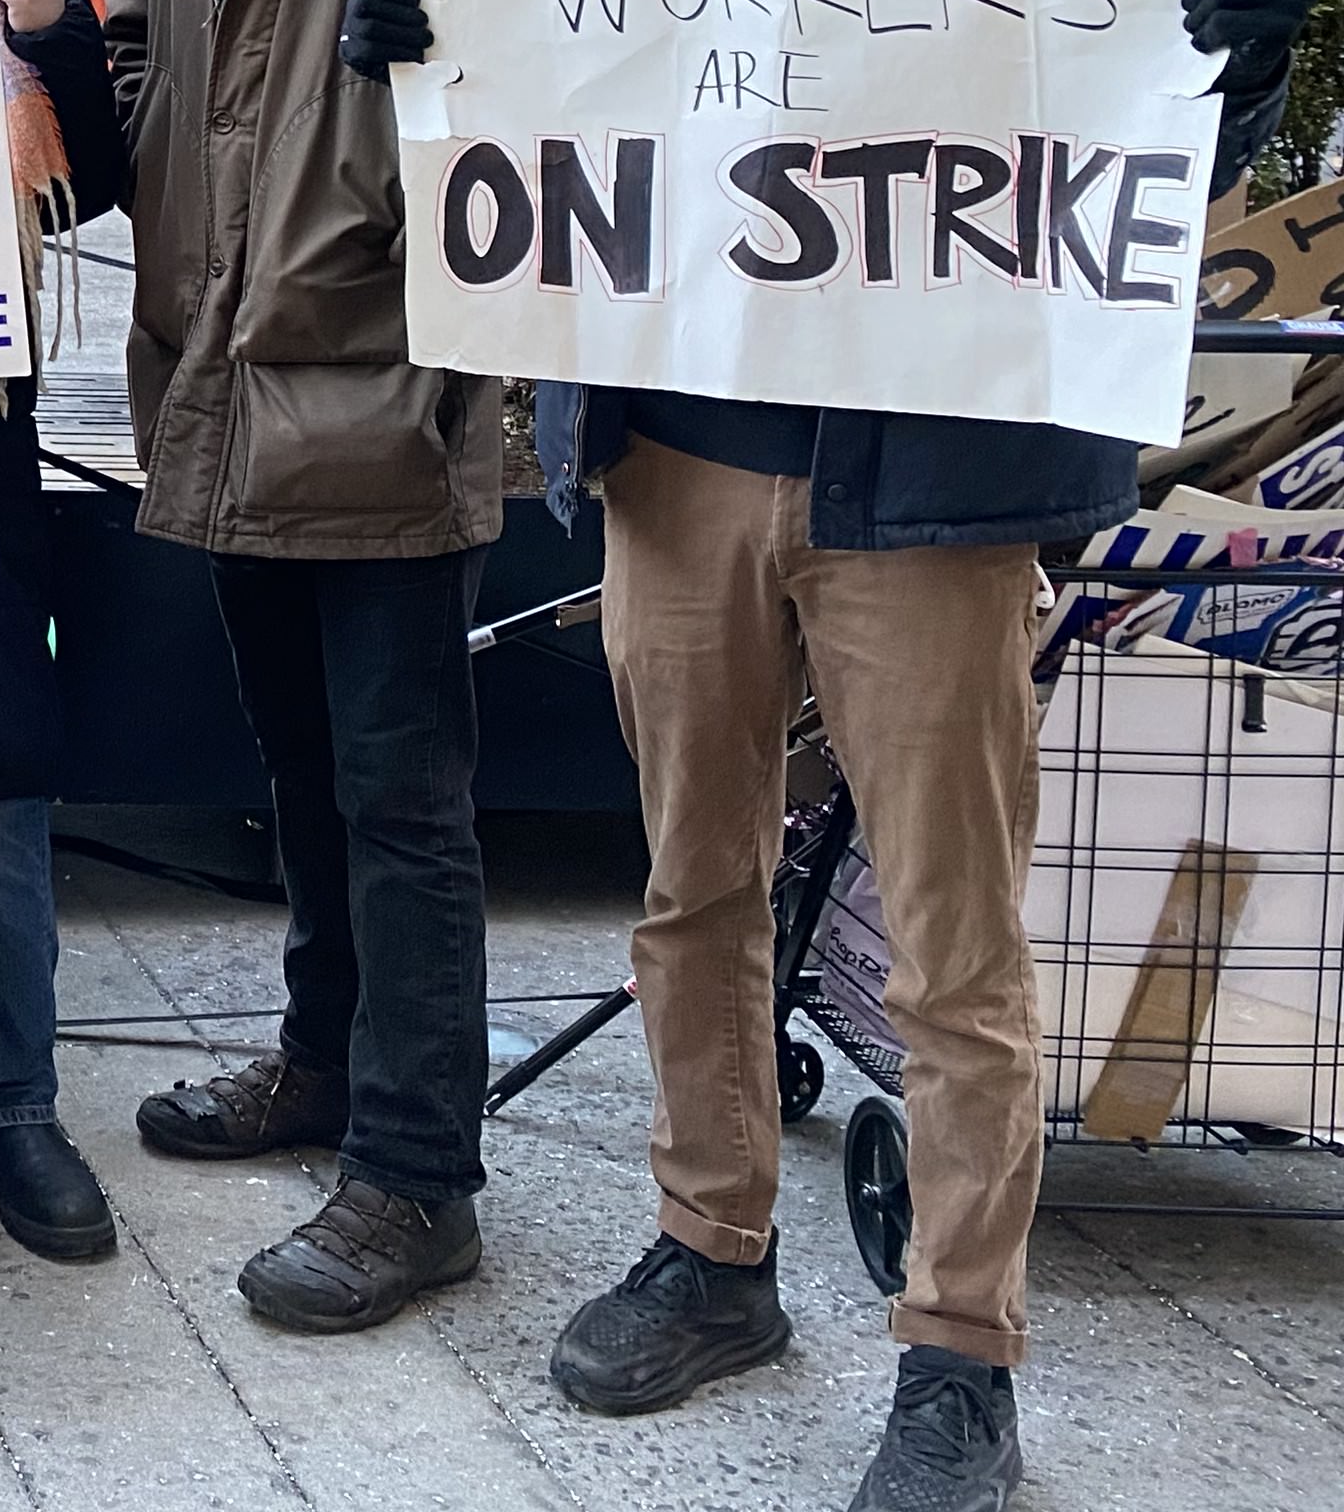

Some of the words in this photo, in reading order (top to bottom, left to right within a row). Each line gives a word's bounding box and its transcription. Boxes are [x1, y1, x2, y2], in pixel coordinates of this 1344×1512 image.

[693, 48, 829, 112] ARE
[436, 131, 664, 300] ON
[720, 129, 1200, 309] STRIKE
